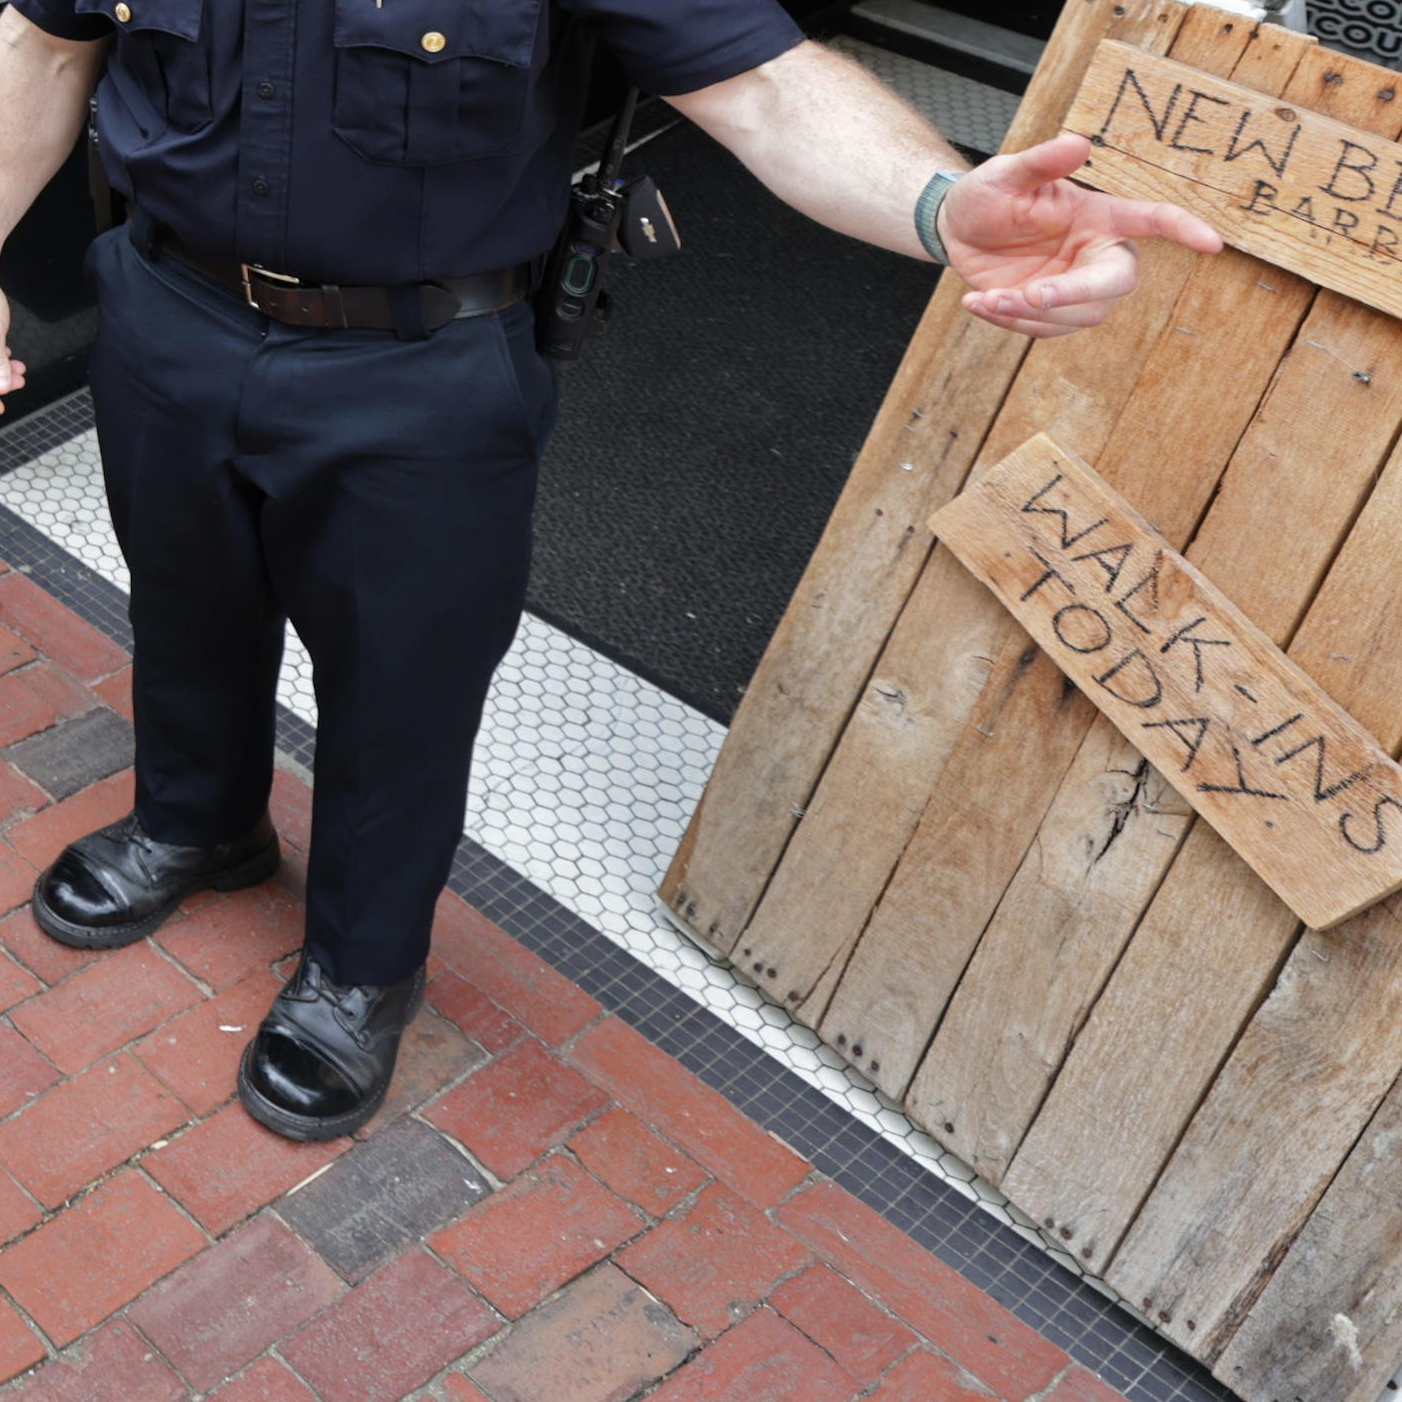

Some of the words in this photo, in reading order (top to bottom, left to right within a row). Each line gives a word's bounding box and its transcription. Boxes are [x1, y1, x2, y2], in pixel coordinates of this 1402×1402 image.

[1096, 68, 1302, 179] NEW
[1019, 546, 1291, 802] TODAY
[1022, 474, 1402, 855] WALK-INS
